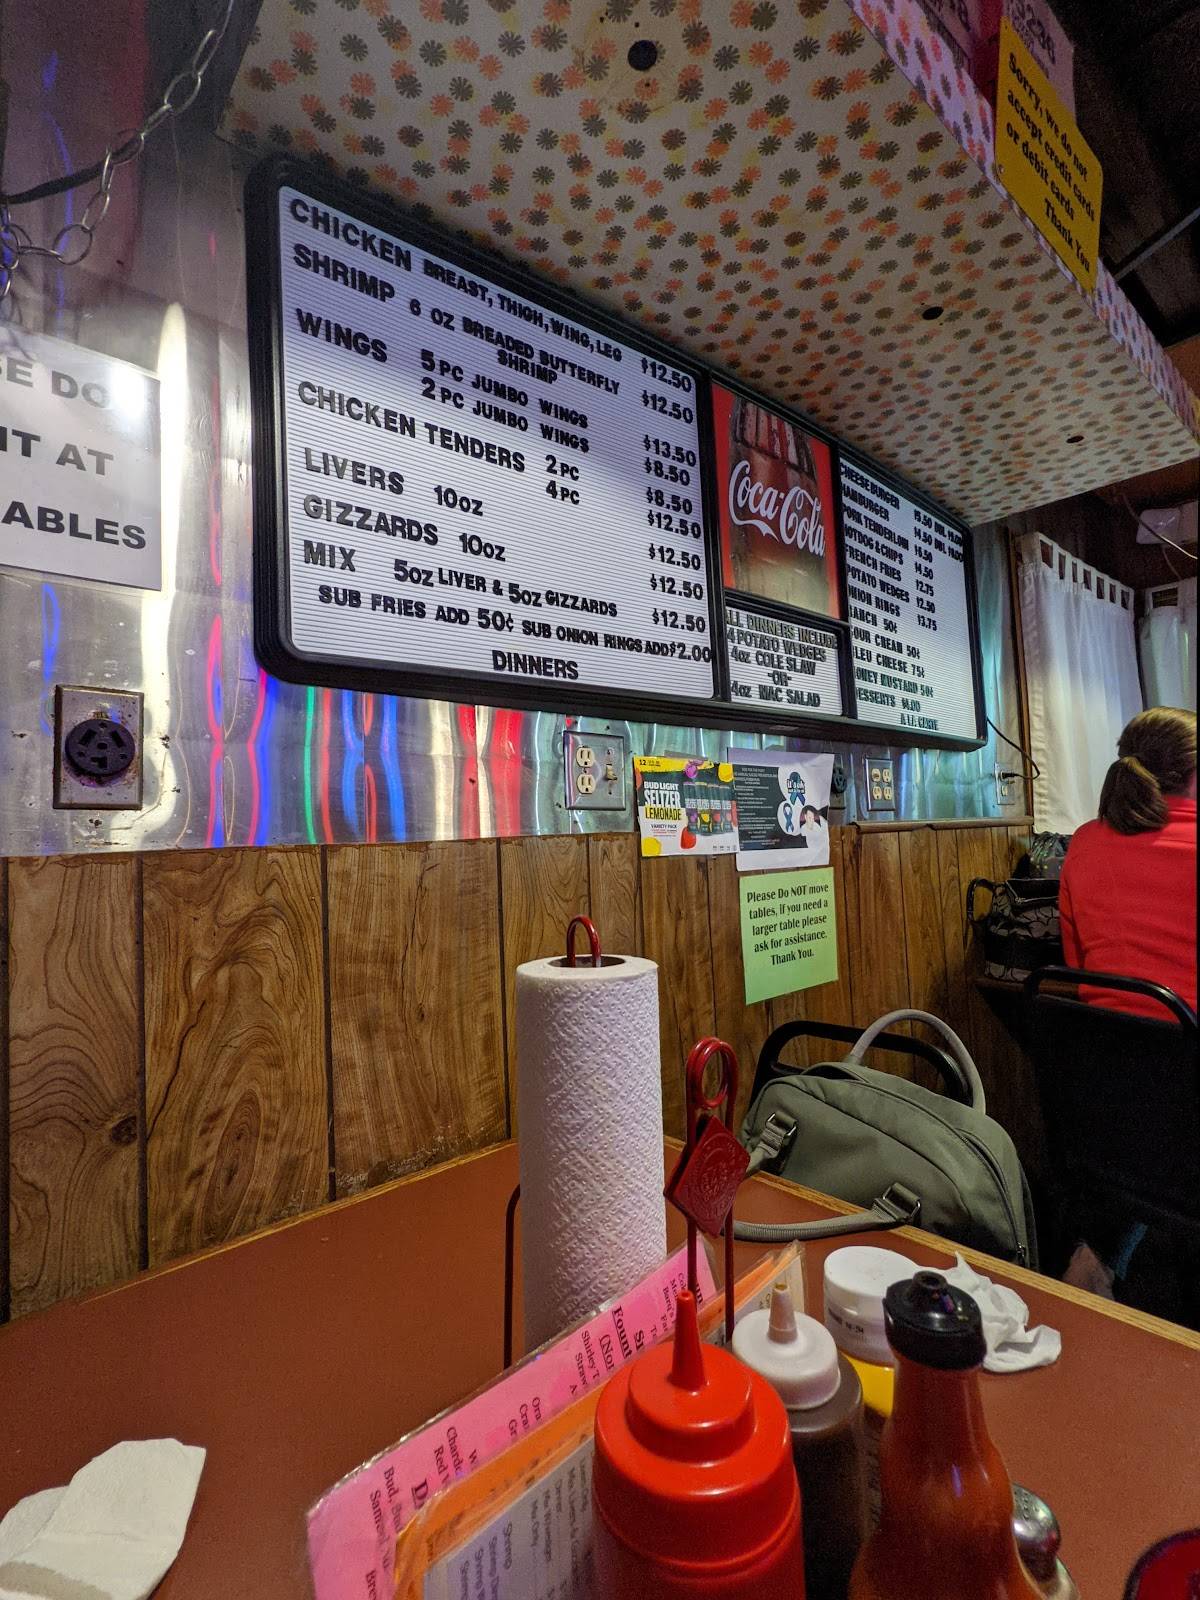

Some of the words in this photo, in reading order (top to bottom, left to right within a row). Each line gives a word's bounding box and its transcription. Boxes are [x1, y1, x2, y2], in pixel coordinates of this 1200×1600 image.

[1009, 52, 1043, 117] Sorry,
[1045, 107, 1059, 138] we
[1061, 132, 1072, 156] do
[1073, 153, 1087, 182] not
[1007, 121, 1020, 145] or
[1022, 141, 1049, 185] debit
[1008, 89, 1043, 144] accept
[1044, 141, 1072, 188] credit
[1073, 183, 1094, 222] cards
[1045, 197, 1073, 249] Thank
[1076, 239, 1090, 273] You
[290, 198, 412, 272] CHICKEN
[423, 258, 493, 308] BREAST,
[640, 357, 692, 393] $12.50
[293, 242, 395, 302] SHRIMP
[410, 298, 421, 316] 6
[430, 307, 455, 332] OZ
[462, 316, 535, 359] BREADED
[539, 349, 620, 395] BUTTERFLY
[641, 389, 694, 425] $12.50
[497, 348, 558, 384] SHRIMP
[52, 370, 111, 408] DO
[296, 307, 388, 363] WINGS
[471, 374, 529, 407] JUMBO
[538, 398, 589, 429] WINGS
[643, 434, 697, 467] $13.50
[56, 443, 114, 476] AT
[297, 381, 416, 439] CHICKEN
[424, 422, 526, 473] TENDERS
[646, 486, 693, 515] $8.50
[472, 400, 529, 432] JUMBO
[540, 423, 590, 454] WINGS
[644, 456, 691, 486] $8.50
[2, 500, 147, 550] ABLES
[304, 446, 405, 496] LIVERS
[648, 543, 701, 571] $12.50
[647, 509, 701, 539] $12.50
[729, 460, 826, 558] Coca-Cola
[303, 494, 439, 546] GIZZARDS
[650, 573, 704, 600] $12.50
[845, 544, 878, 571] FRENCH
[880, 561, 902, 582] FRIES
[303, 540, 357, 573] MIX
[438, 567, 487, 593] LIVER
[492, 579, 503, 596] &
[545, 590, 618, 617] GIZZARDS
[652, 607, 706, 633] $12.50
[847, 564, 877, 588] POTATO
[879, 579, 910, 603] WEDGES
[318, 584, 362, 609] SUB
[370, 593, 427, 619] FRIES
[434, 605, 470, 626] ADD
[477, 607, 514, 632] 50¢
[522, 620, 552, 639] SUB
[556, 625, 599, 646] ONION
[603, 633, 643, 653] RINGS
[874, 596, 901, 617] RINGS
[737, 628, 780, 652] POTATO
[783, 640, 827, 662] WEDGES
[746, 613, 796, 639] DINNERS
[798, 627, 837, 649] INCLUDE
[851, 626, 871, 644] OUR
[874, 633, 903, 654] CREAM
[492, 649, 579, 680] DINNERS
[755, 650, 785, 670] COLE
[786, 657, 816, 675] SLAW
[853, 646, 872, 663] LEU
[876, 653, 908, 674] CHEESE
[758, 685, 783, 702] MAC
[786, 689, 821, 707] SALAD
[854, 666, 878, 684] ONEY
[880, 672, 919, 694] MUSTARD
[856, 687, 896, 708] ESSERTS
[643, 781, 659, 789] BUD
[660, 782, 679, 791] LIGHT
[643, 789, 682, 809] SELTZER
[645, 807, 681, 820] LEMONADE
[747, 890, 776, 903] Please
[778, 888, 789, 899] Do
[790, 884, 808, 896] NOT
[809, 884, 829, 895] move
[749, 907, 778, 920] tables,
[786, 904, 801, 916] you
[803, 899, 822, 911] need
[823, 899, 829, 908] a
[752, 923, 778, 936] larger
[780, 918, 800, 931] table
[802, 914, 827, 929] please
[754, 940, 769, 953] ask
[771, 938, 783, 949] for
[784, 930, 828, 947] assistance.
[771, 951, 796, 966] Thank
[798, 948, 815, 959] You.
[581, 1329, 597, 1370] Shirley
[434, 1445, 447, 1475] Red
